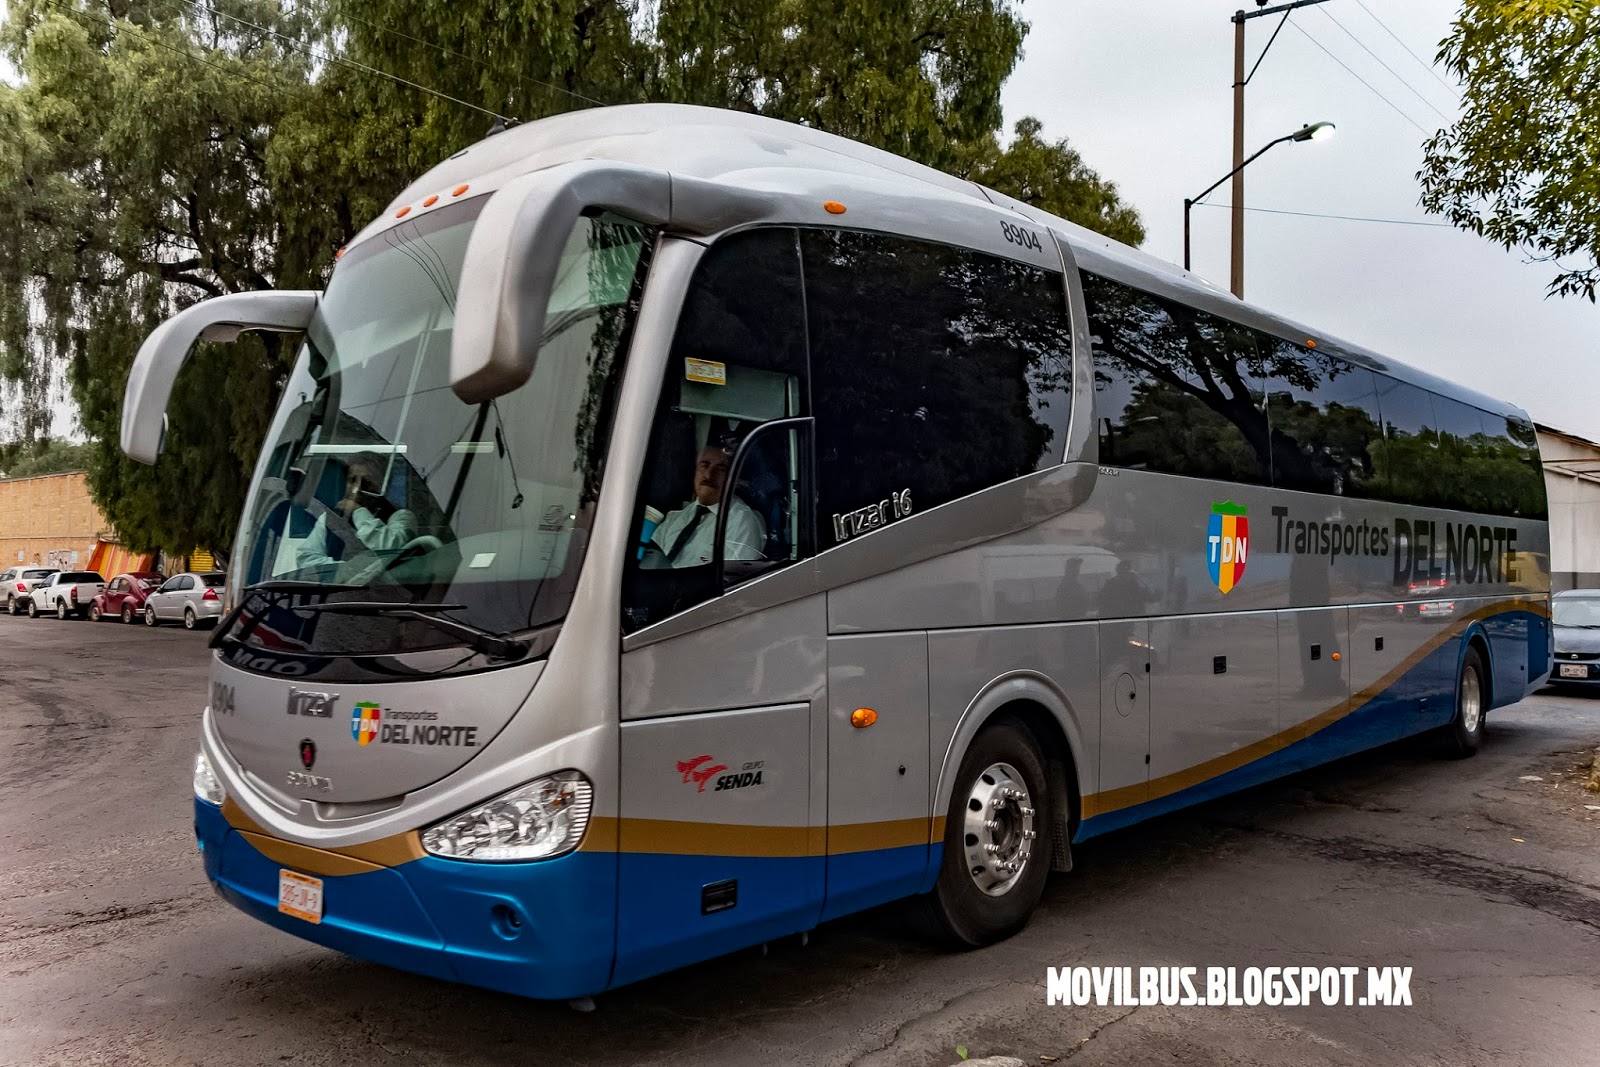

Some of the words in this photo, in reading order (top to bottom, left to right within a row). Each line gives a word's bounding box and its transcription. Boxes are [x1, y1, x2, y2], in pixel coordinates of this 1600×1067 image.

[1000, 220, 1042, 253] 8904
[832, 498, 889, 542] Irizar
[892, 487, 912, 519] i6
[1208, 535, 1247, 564] TDN
[1271, 505, 1389, 566] Transportes
[1393, 518, 1442, 587] DEL
[1445, 522, 1518, 585] NORTE
[351, 717, 379, 733] TDN
[384, 708, 438, 722] Transportes
[381, 724, 410, 744] DEL
[412, 725, 478, 747] NORTE
[714, 770, 762, 792] SENDA
